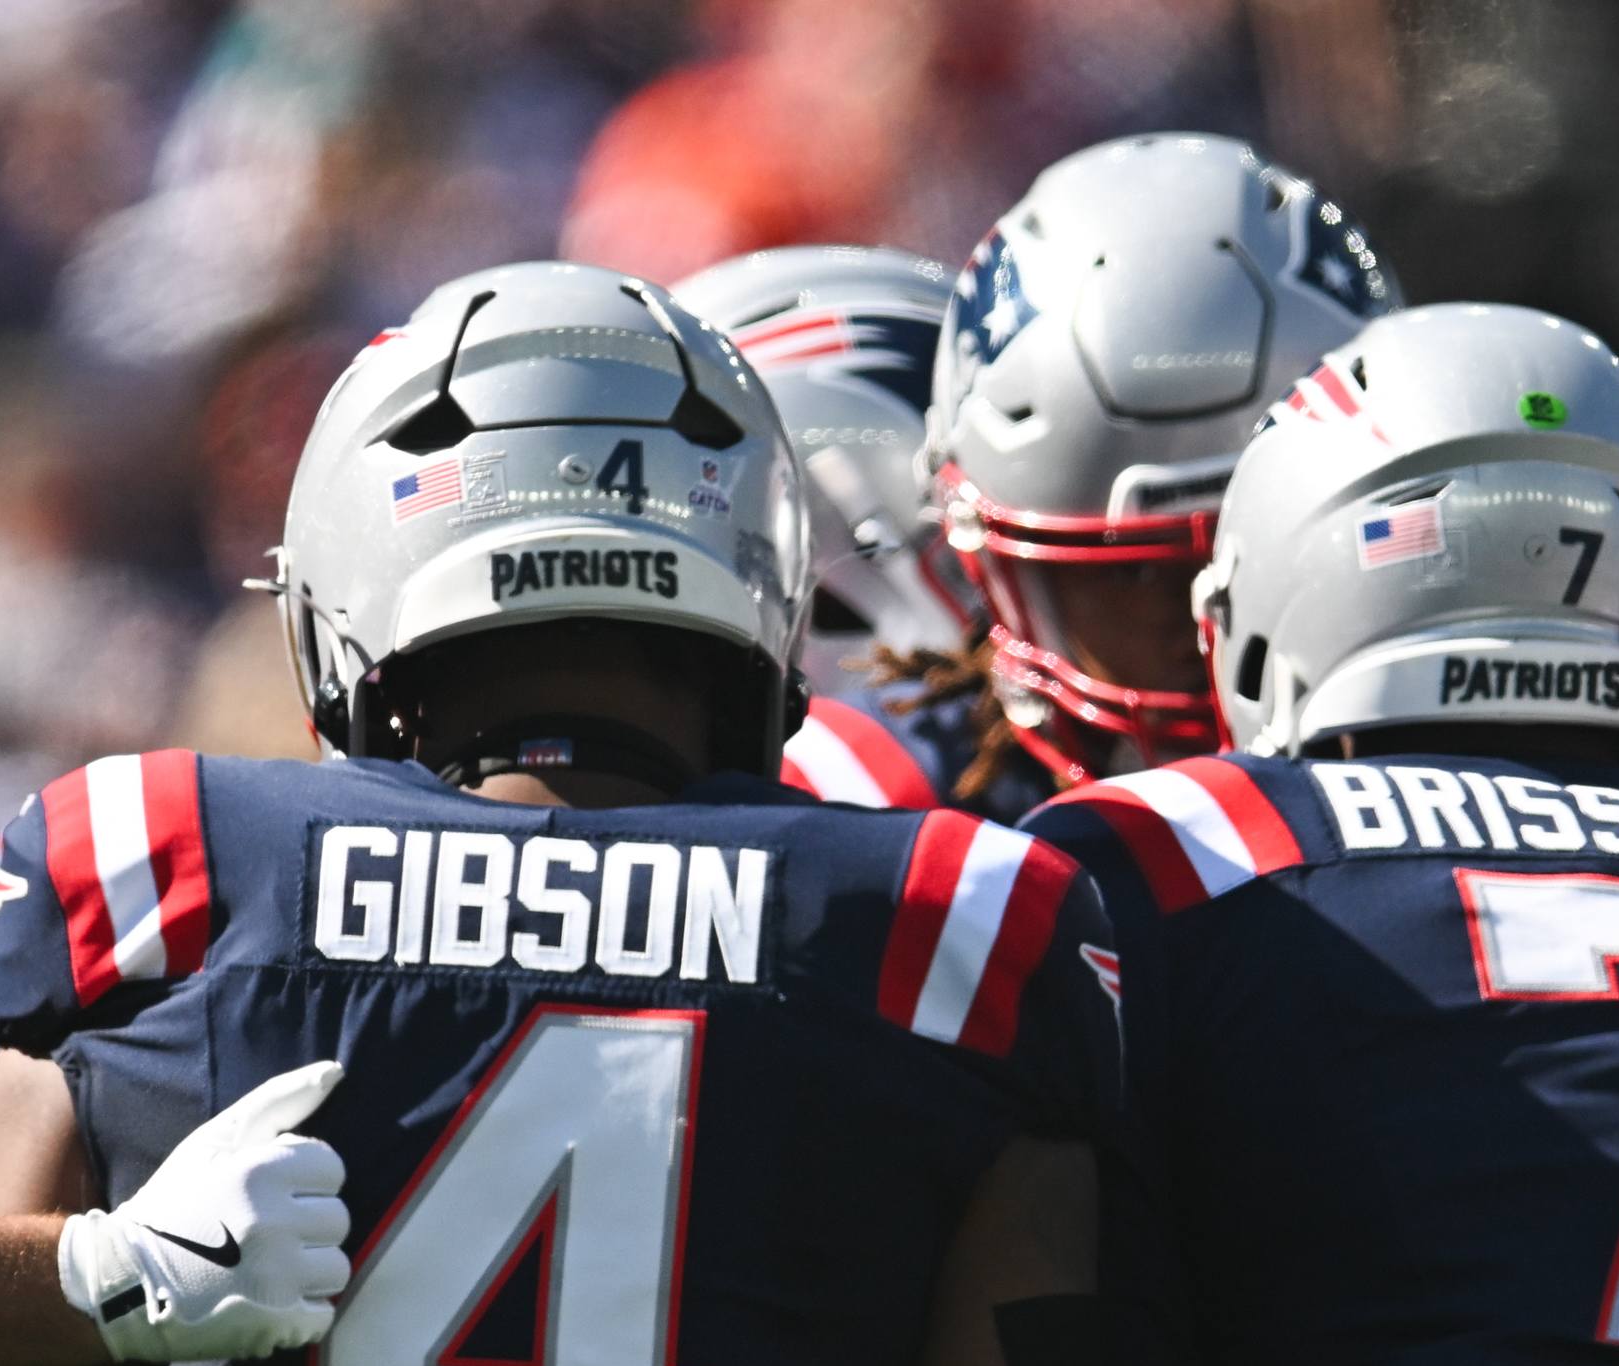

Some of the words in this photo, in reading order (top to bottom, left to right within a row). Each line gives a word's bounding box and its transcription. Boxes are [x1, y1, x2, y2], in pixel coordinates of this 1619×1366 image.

[596, 439, 648, 515] 4
[492, 549, 679, 601] PATRIOTS
[1559, 527, 1603, 604] 7
[314, 826, 771, 983] GIBSON
